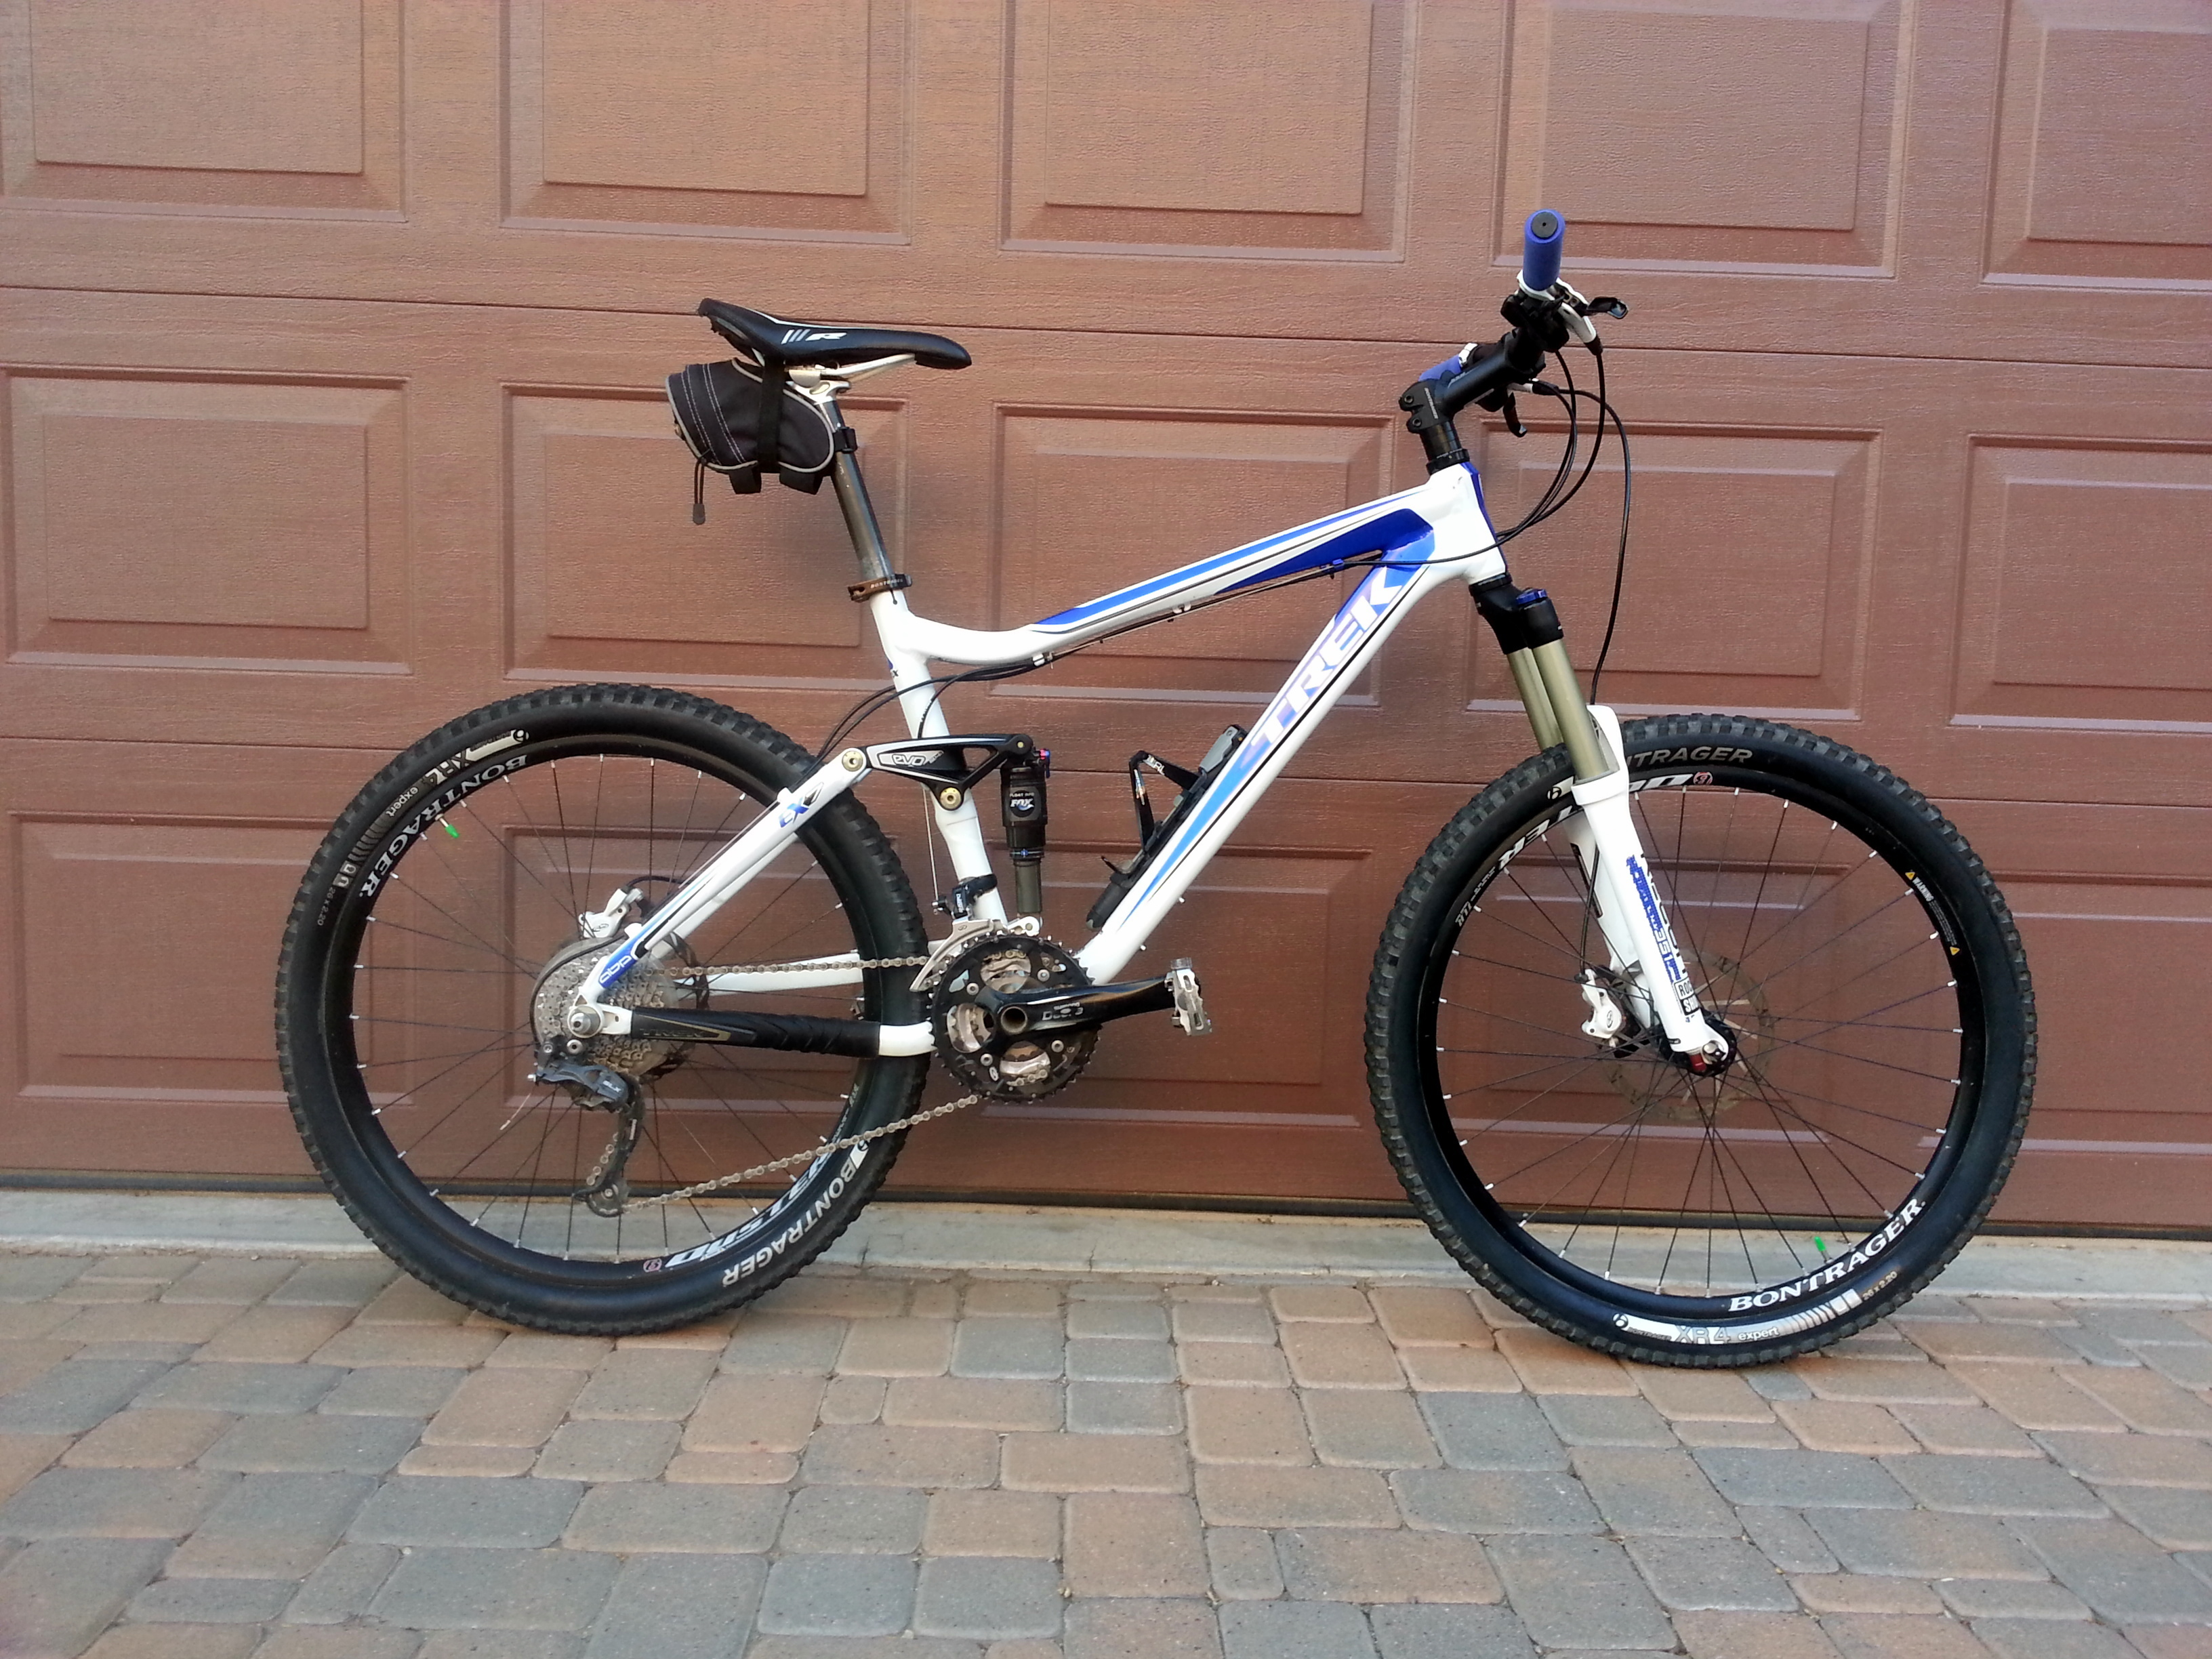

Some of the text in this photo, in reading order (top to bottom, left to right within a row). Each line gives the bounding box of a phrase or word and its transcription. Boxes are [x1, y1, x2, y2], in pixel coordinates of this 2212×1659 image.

[1250, 567, 1402, 745] TREK
[422, 750, 474, 785] XR4
[1626, 746, 1753, 768] TRAGER
[386, 786, 419, 817] expert
[1010, 798, 1034, 811] FOX
[360, 754, 527, 898] BONTRAGER
[327, 886, 335, 899] 26
[1912, 876, 1935, 902] WARNING
[722, 1156, 856, 1288] BONTRAGER
[1729, 1198, 1921, 1312] BONTRAGER
[1862, 1288, 1875, 1300] 26
[1879, 1271, 1898, 1289] 2.20
[1675, 1325, 1730, 1345] XR4
[1738, 1326, 1779, 1342] expert
